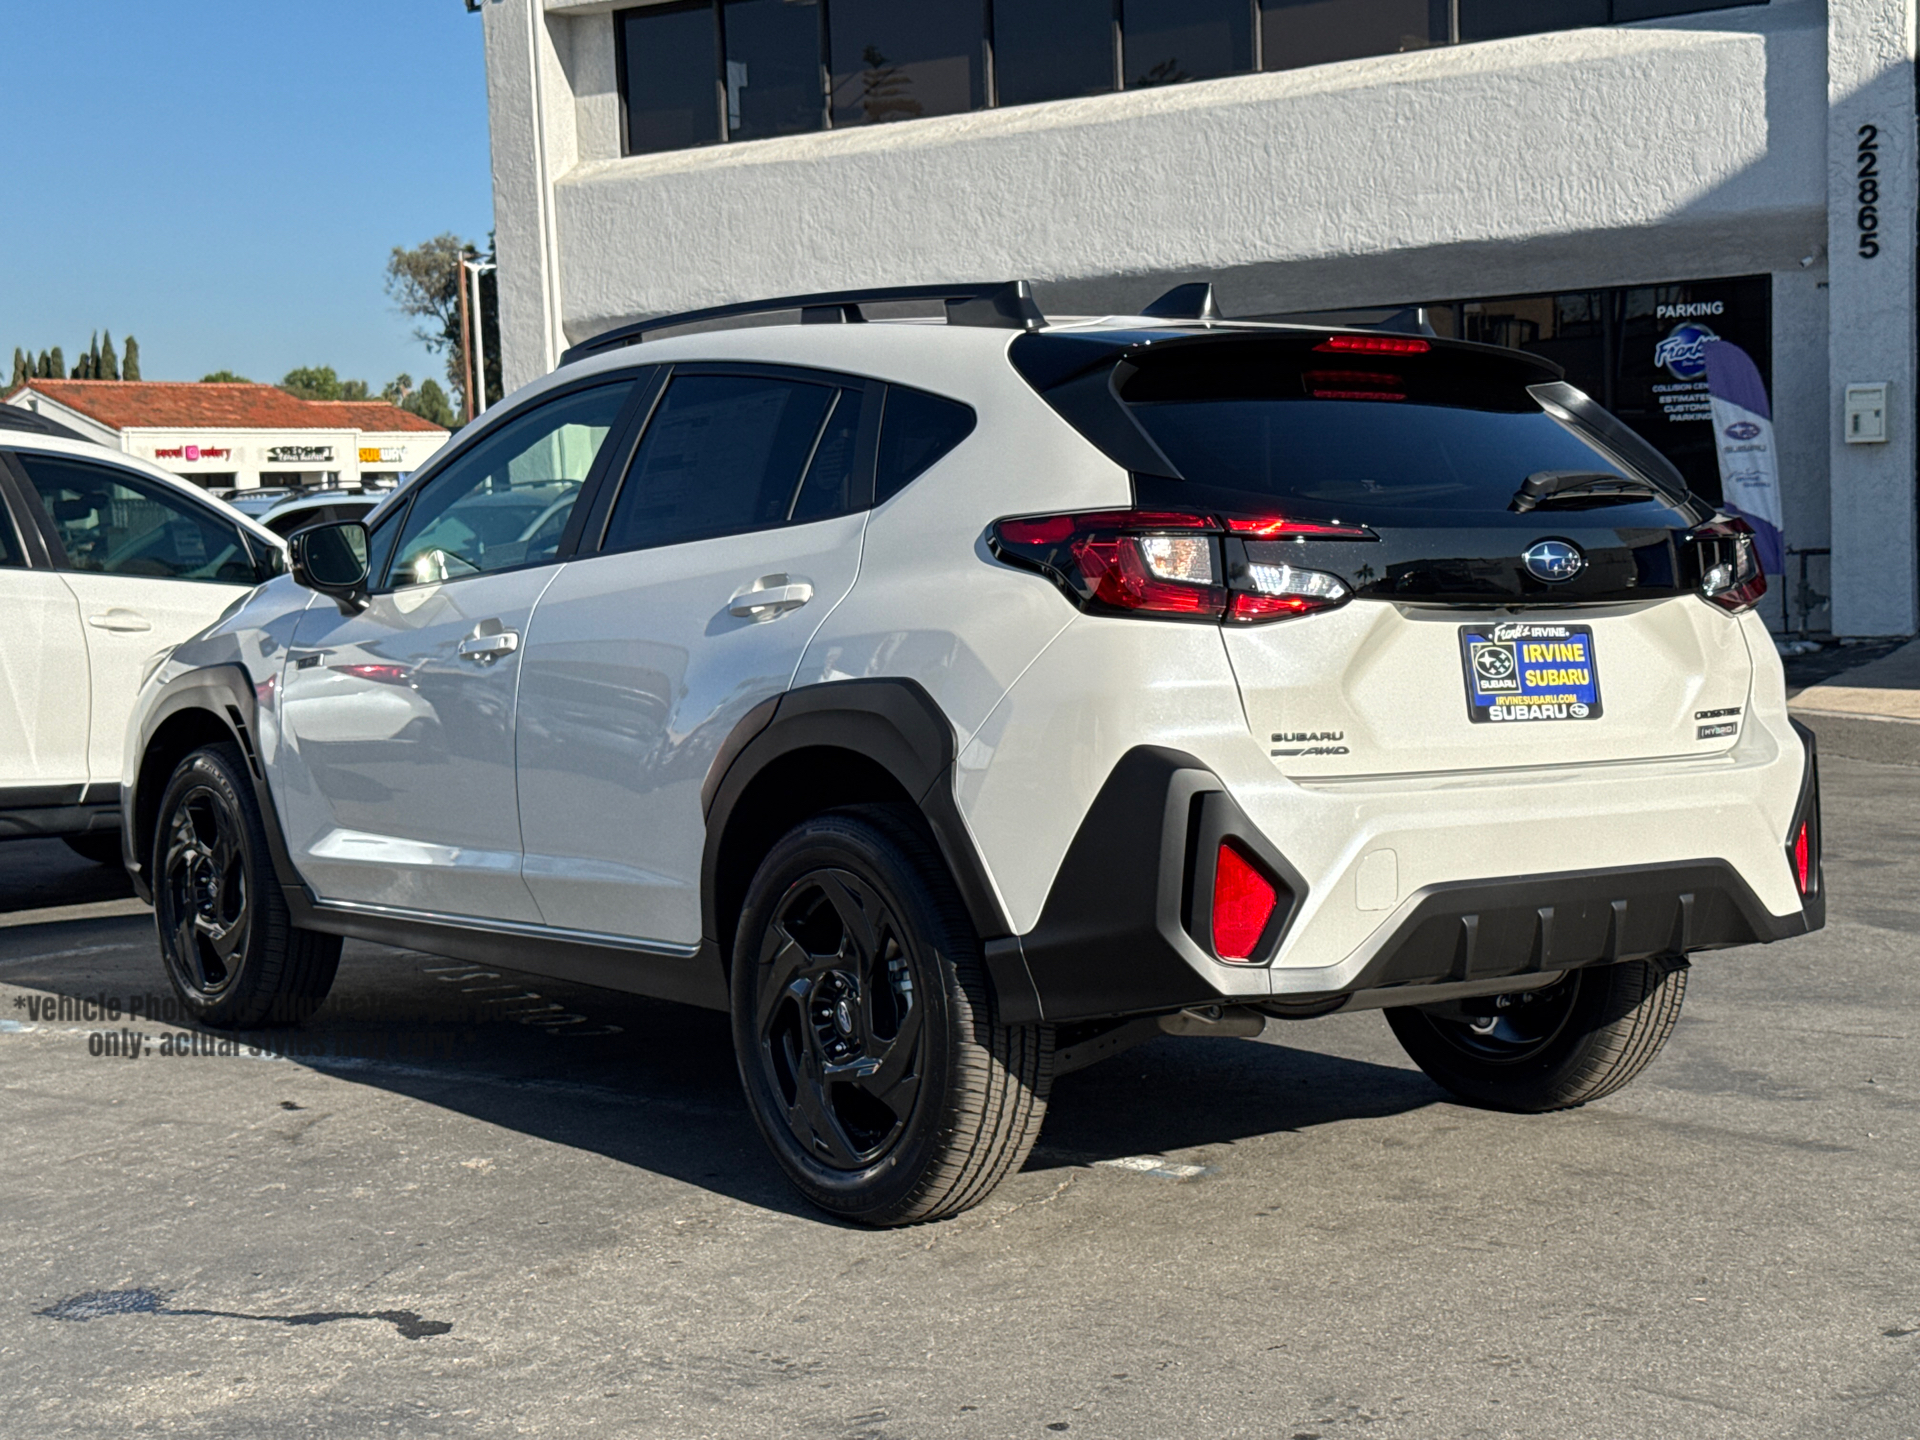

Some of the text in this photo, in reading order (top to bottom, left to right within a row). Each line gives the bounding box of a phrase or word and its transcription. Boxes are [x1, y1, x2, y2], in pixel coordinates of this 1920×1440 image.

[1857, 124, 1880, 259] 22865
[1656, 301, 1724, 319] PARKING
[1652, 382, 1709, 393] COLLISION CEN
[1664, 403, 1711, 413] CUSTOME
[358, 446, 405, 463] SUBWAY
[1531, 627, 1565, 638] IRVINE
[1523, 643, 1586, 663] IRVINE
[1480, 679, 1517, 689] SUBARU
[1525, 668, 1590, 687] SUBARU
[1496, 694, 1577, 706] IRVINESUBARU.COM
[1489, 704, 1568, 721] SUBARU
[1271, 731, 1344, 742] SUBARU
